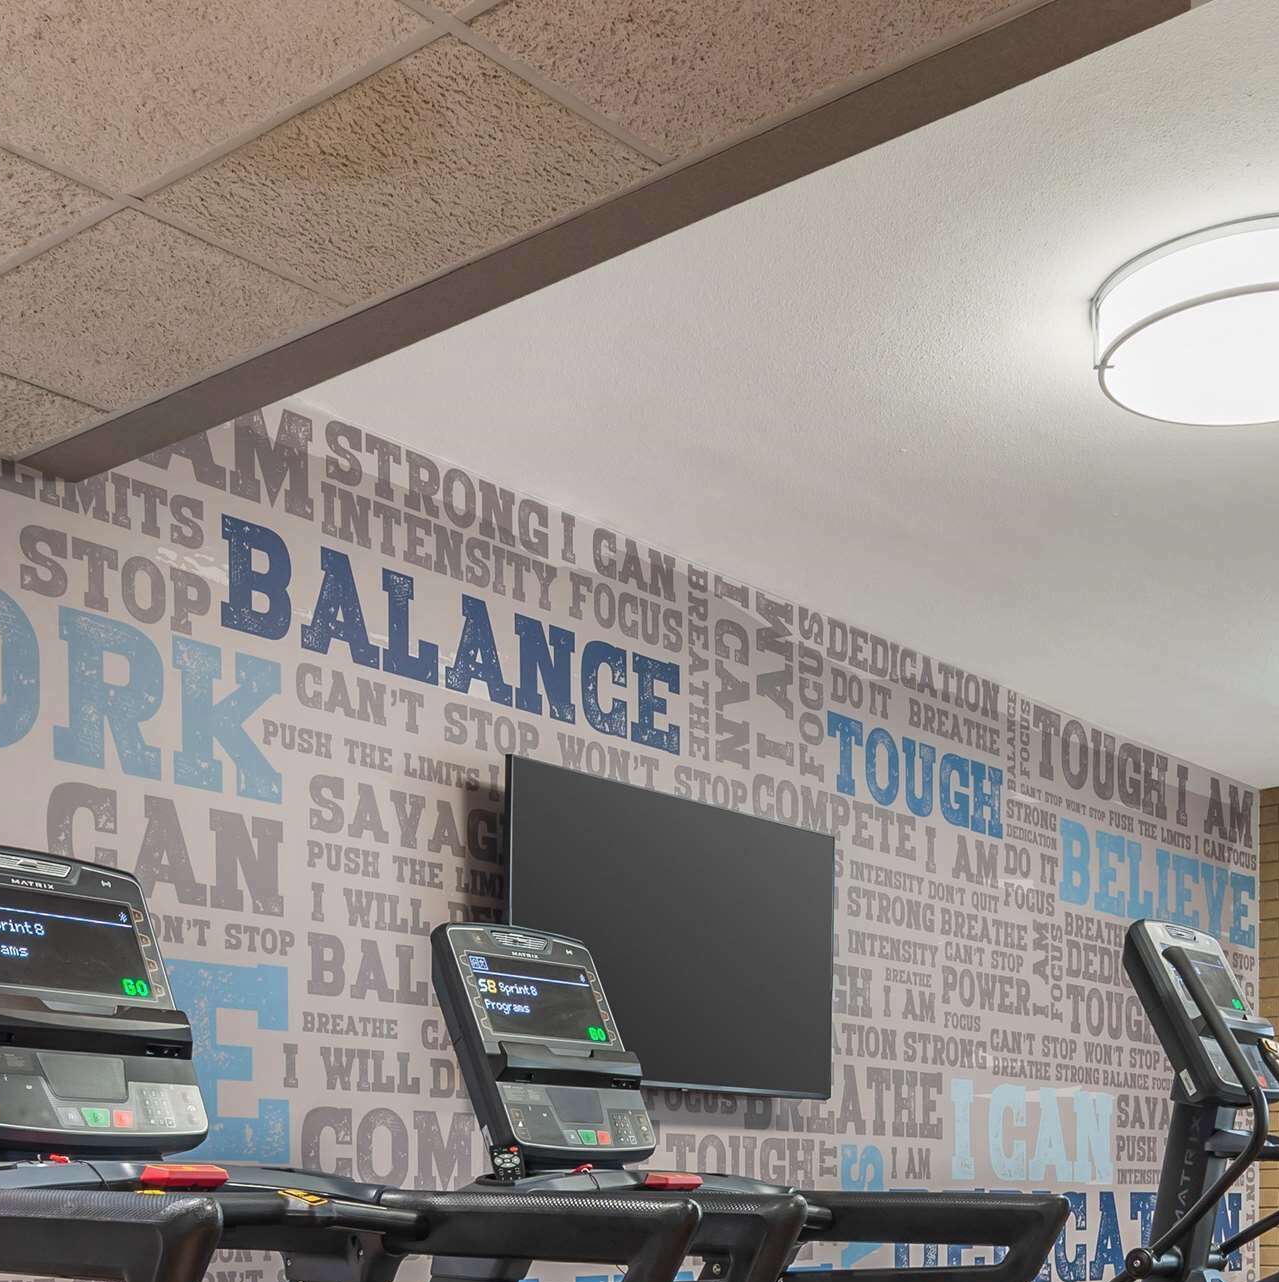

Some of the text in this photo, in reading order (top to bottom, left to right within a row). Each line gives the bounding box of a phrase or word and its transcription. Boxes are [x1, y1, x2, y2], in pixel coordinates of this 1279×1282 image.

[325, 420, 549, 559] STRONG
[19, 524, 211, 635] STOP
[321, 482, 684, 653] INTENSITY FOCUS
[561, 512, 677, 602] I CAN
[220, 512, 681, 755] BALANCE
[687, 564, 710, 762] BREATHE
[714, 575, 751, 770] I CAN
[756, 591, 795, 767] I AM
[826, 616, 1001, 722] DEDICATION
[798, 604, 825, 783] FOCUS
[830, 667, 1001, 758] DO IT BREATHE
[263, 718, 333, 759] PUSH
[344, 738, 393, 774] THE
[404, 752, 481, 792] LIMITS
[296, 663, 748, 812] CAN'T STOP WON'T STOP
[827, 710, 1004, 840] TOUGH
[1032, 704, 1254, 849] TOUGH I AM
[309, 774, 505, 866] SAVAG
[752, 773, 999, 889] COMPETE I AM
[1006, 799, 1057, 833] STRONG
[1006, 824, 1057, 851] DEDICATION
[1138, 820, 1158, 841] THE
[1161, 827, 1192, 851] LIMITS
[47, 781, 285, 918] CAN
[307, 840, 444, 890] PUSH THE
[1004, 843, 1058, 887] DO IT
[11, 878, 55, 890] MATRIX
[311, 882, 325, 922] I
[343, 887, 430, 937] WILL
[849, 860, 925, 895] INTENSITY
[928, 880, 966, 906] DON'T
[971, 891, 1000, 913] QUIT
[1004, 880, 1055, 917] FOCUS
[1059, 817, 1256, 949] BELIEVE
[224, 923, 296, 956] STOP
[847, 886, 1027, 951] STRONG BREATHE
[1064, 912, 1127, 949] BREATH
[511, 950, 539, 959] MATRIX
[848, 929, 1024, 974] INTENSITY CAN'T STOP
[885, 967, 932, 988] BREATHE
[1032, 920, 1050, 984] AM
[1050, 923, 1063, 1024] FOCUS
[902, 989, 936, 1024] AM
[941, 965, 1032, 1017] POWER
[302, 1011, 398, 1040] BREATHE
[944, 1012, 981, 1032] FOCUS
[990, 1028, 1160, 1071] CAN'T STOP WON'T STOP
[283, 1043, 299, 1088] I
[320, 1046, 421, 1095] WILL
[903, 1031, 987, 1069] STRONG
[992, 1055, 1149, 1090] BREATHE STRONG BALANCE
[950, 1078, 1115, 1185] I CAN
[1116, 1136, 1158, 1163] PUSH
[905, 1147, 931, 1180] AM
